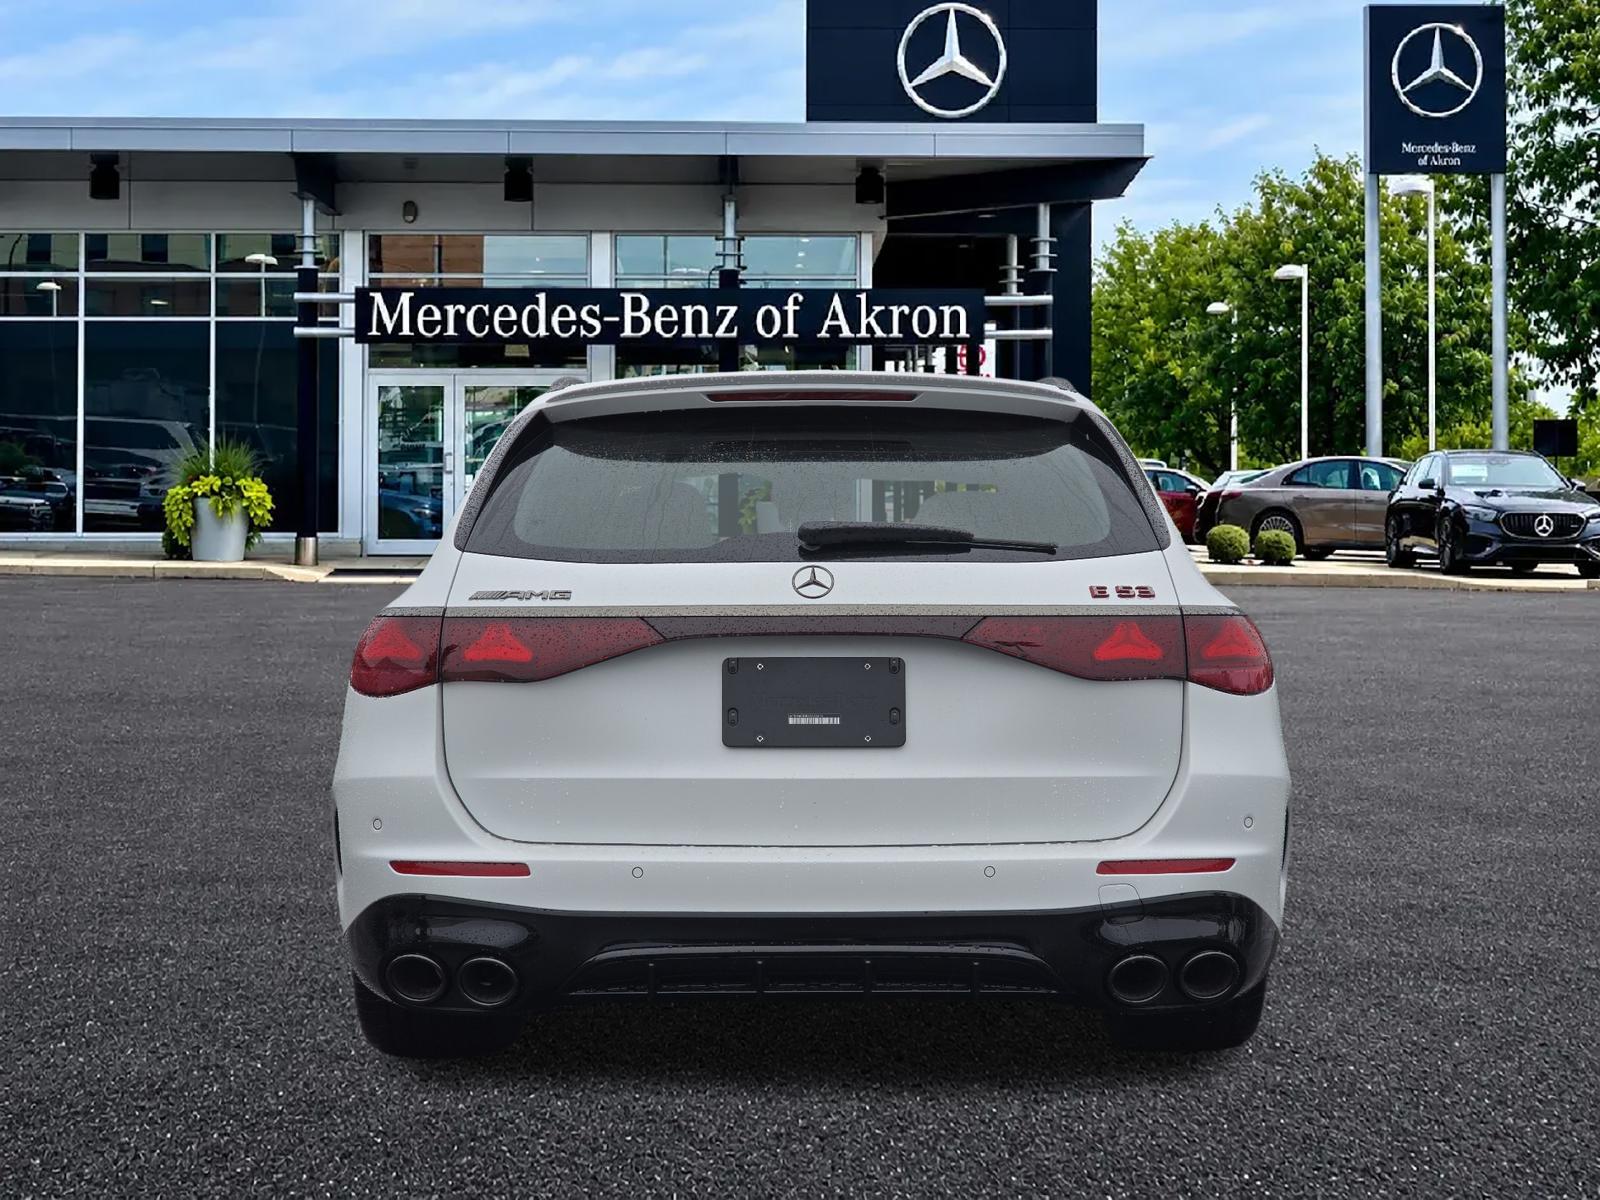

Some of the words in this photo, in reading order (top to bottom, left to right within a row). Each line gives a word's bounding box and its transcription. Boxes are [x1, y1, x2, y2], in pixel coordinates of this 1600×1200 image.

[1401, 142, 1476, 153] Mercedes-Benz
[1417, 154, 1428, 166] of
[1430, 154, 1460, 166] Akron
[367, 291, 739, 338] Mercedes-Benz
[755, 291, 804, 338] of
[816, 291, 971, 338] Akron
[500, 589, 573, 600] AMG
[1088, 585, 1110, 599] E
[1115, 585, 1156, 599] 53
